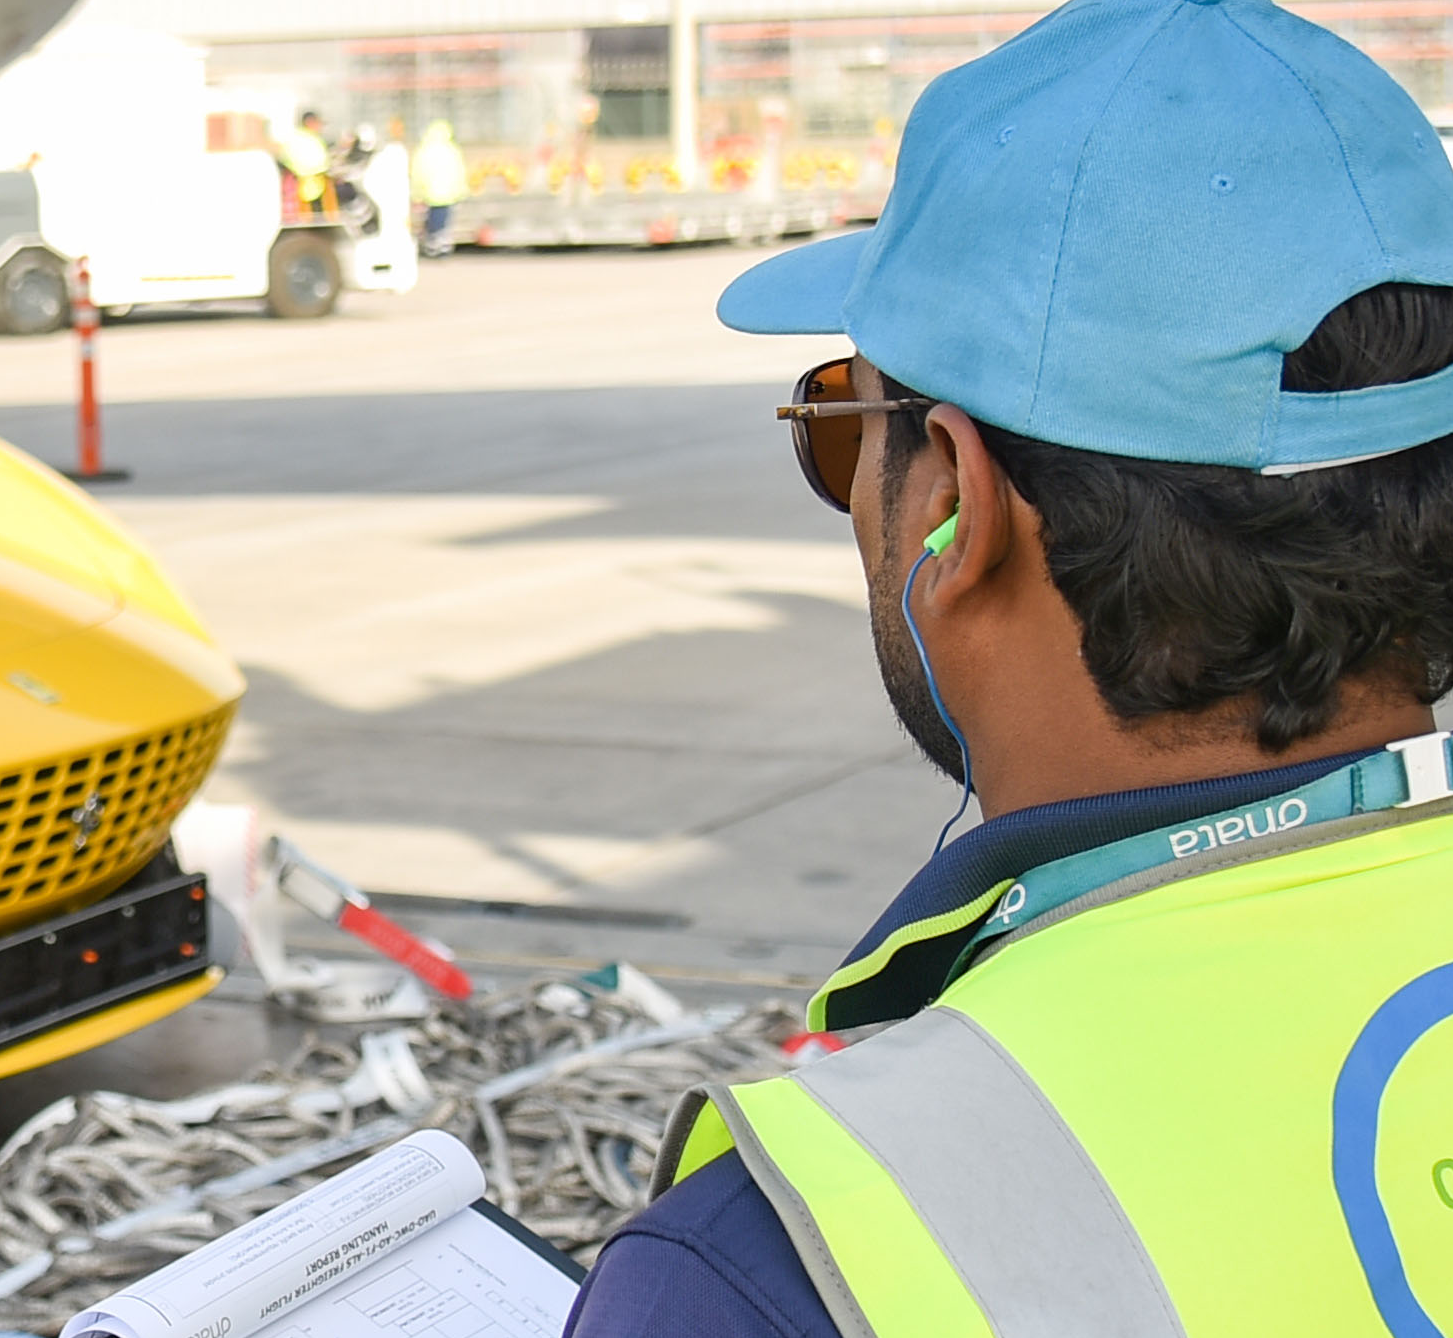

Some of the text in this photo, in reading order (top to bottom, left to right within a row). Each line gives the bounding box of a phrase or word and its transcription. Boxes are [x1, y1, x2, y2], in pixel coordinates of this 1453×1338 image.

[1167, 798, 1308, 860] dnata
[306, 1219, 390, 1277] HANDLING REPORT
[292, 1261, 344, 1300] FREIGHTER
[259, 1291, 293, 1320] FLIGHT
